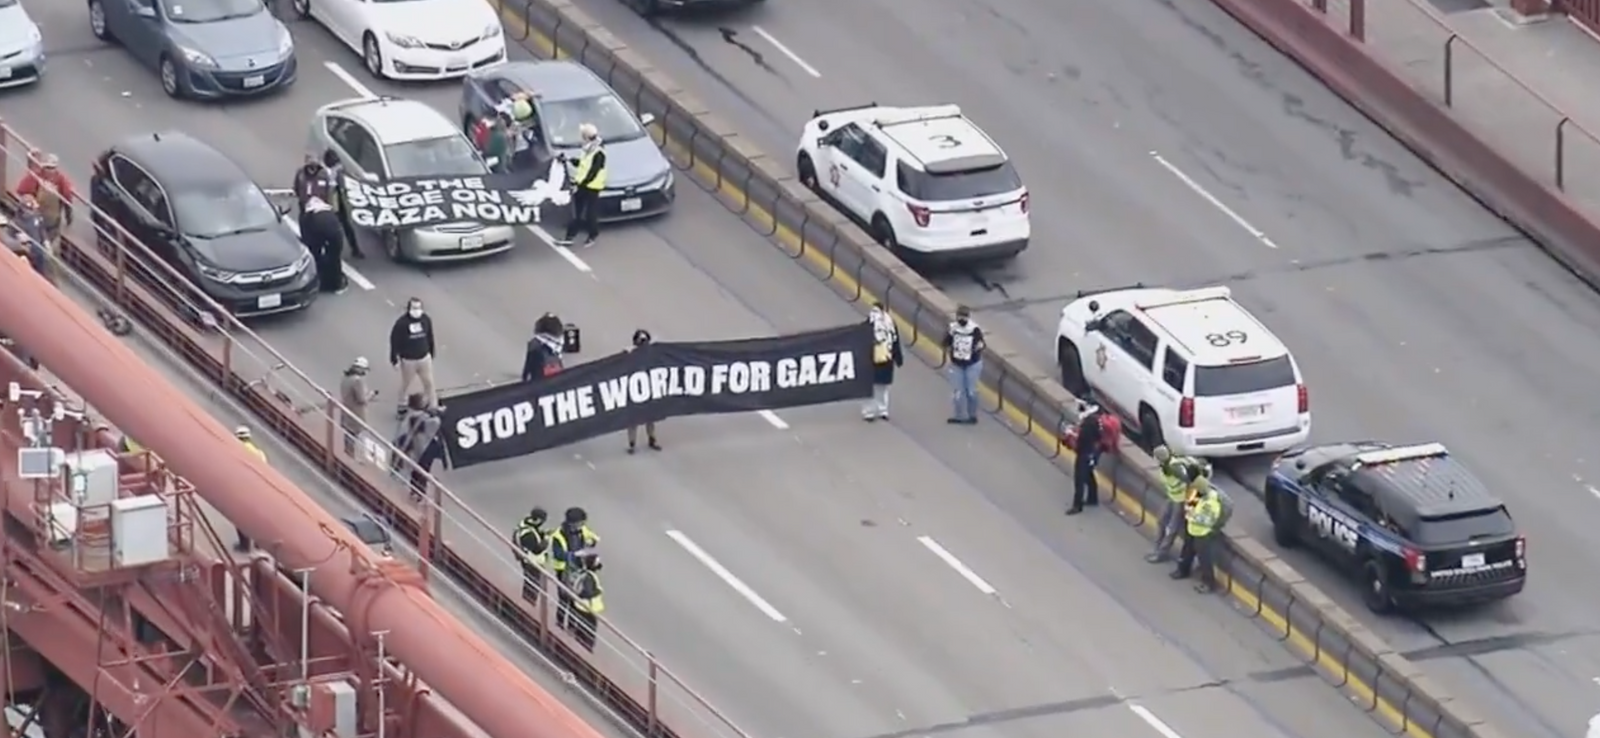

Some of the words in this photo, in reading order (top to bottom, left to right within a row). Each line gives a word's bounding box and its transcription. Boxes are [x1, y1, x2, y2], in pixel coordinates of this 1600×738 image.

[929, 134, 962, 149] 3
[416, 177, 484, 190] THE
[452, 189, 501, 203] ON
[351, 204, 447, 226] GAZA
[452, 203, 541, 223] NOW!
[1205, 330, 1248, 347] 89
[456, 401, 534, 448] STOP
[538, 385, 595, 427] THE
[599, 366, 705, 411] WORLD
[711, 361, 771, 394] FOR
[776, 351, 856, 388] GAZA
[1308, 504, 1358, 551] POLICE
